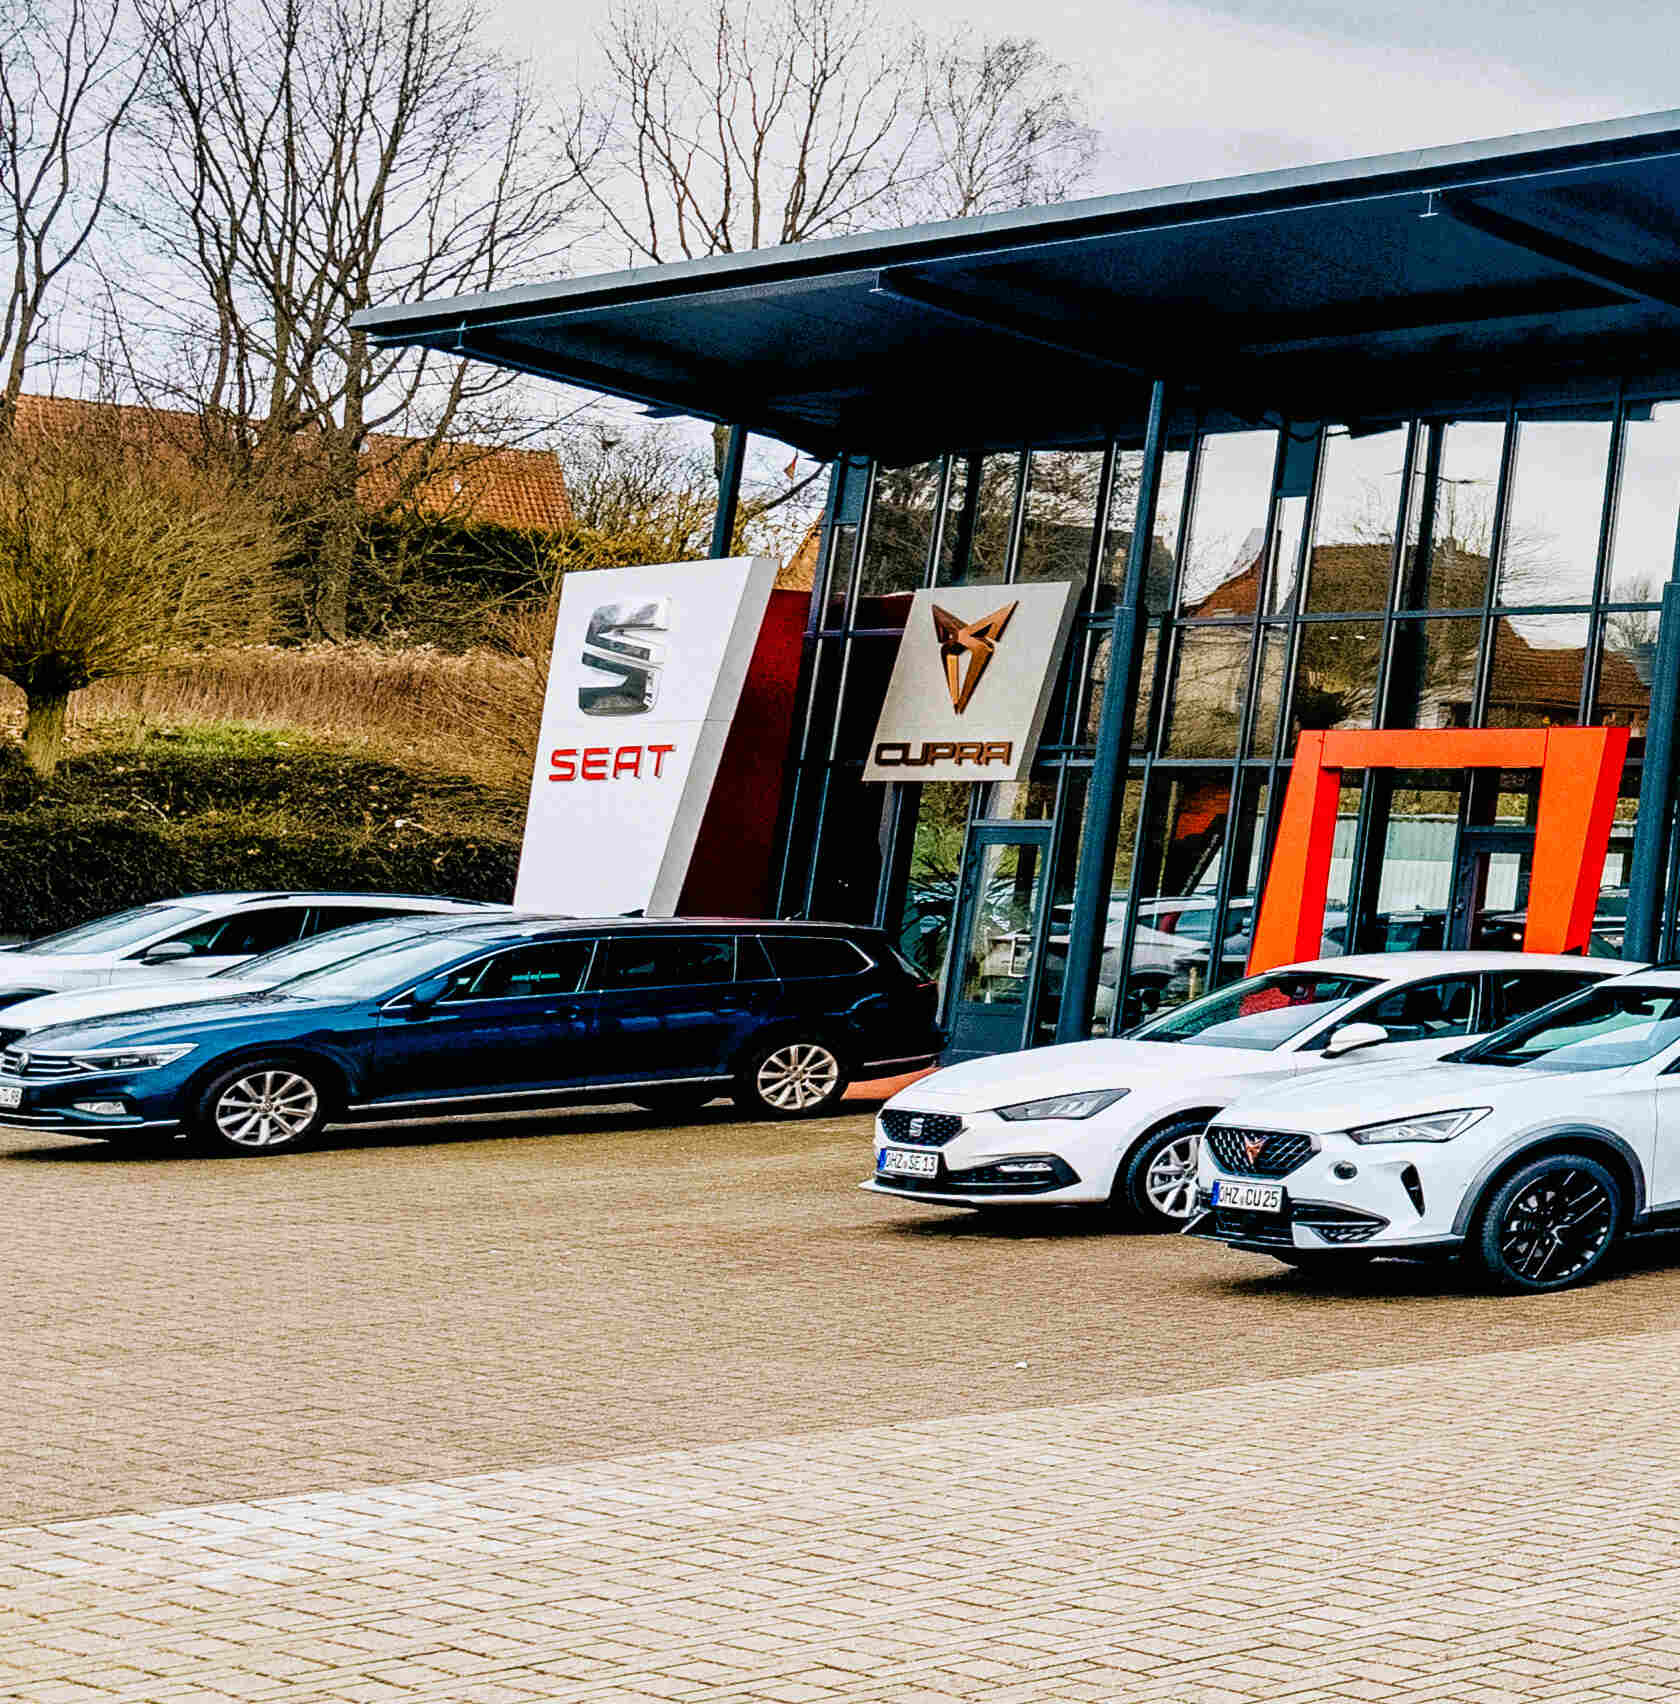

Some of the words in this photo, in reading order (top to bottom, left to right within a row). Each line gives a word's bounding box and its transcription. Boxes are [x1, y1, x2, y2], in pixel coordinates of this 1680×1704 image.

[548, 743, 677, 782] SEAT
[874, 741, 1013, 767] CUPRA
[1219, 1185, 1240, 1204] OHZ
[1246, 1188, 1262, 1207] CU
[1263, 1190, 1279, 1208] 25
